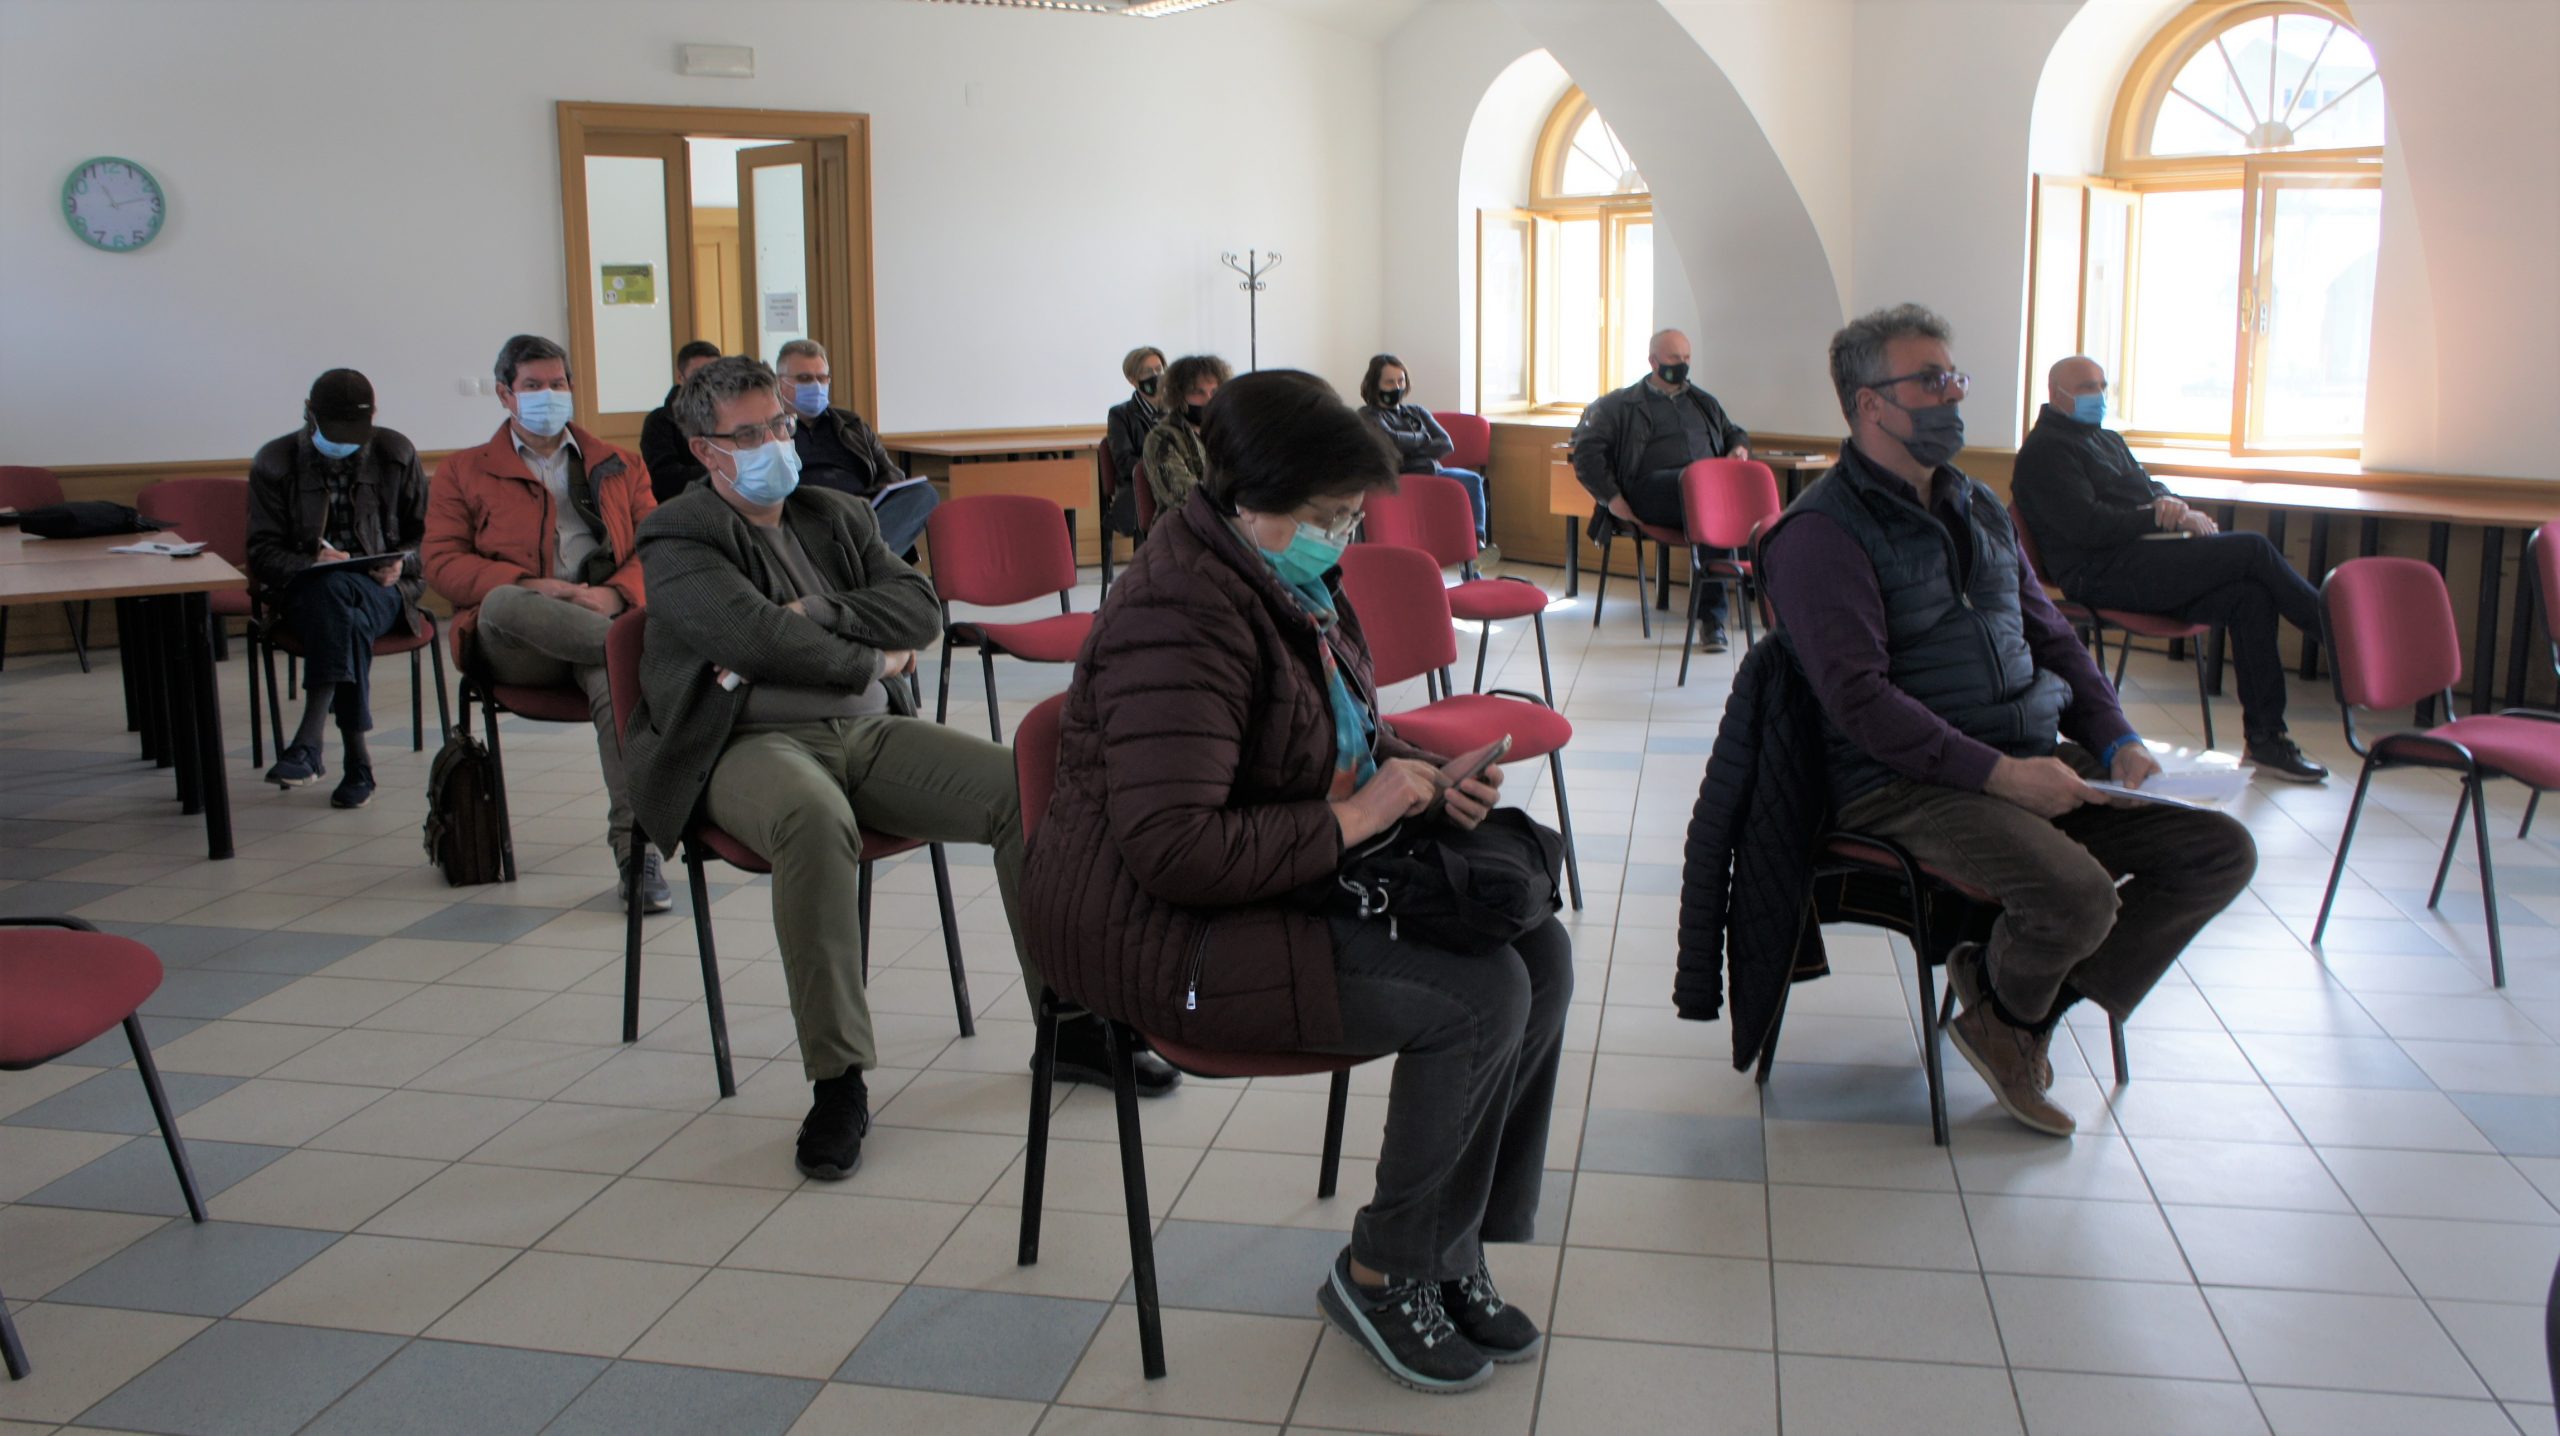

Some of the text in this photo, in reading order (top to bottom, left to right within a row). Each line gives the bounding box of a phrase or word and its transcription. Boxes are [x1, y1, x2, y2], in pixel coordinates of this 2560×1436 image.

[103, 161, 122, 174] 12
[151, 196, 161, 214] 3
[93, 230, 106, 244] 7
[112, 234, 126, 248] 6
[132, 230, 144, 245] 5
